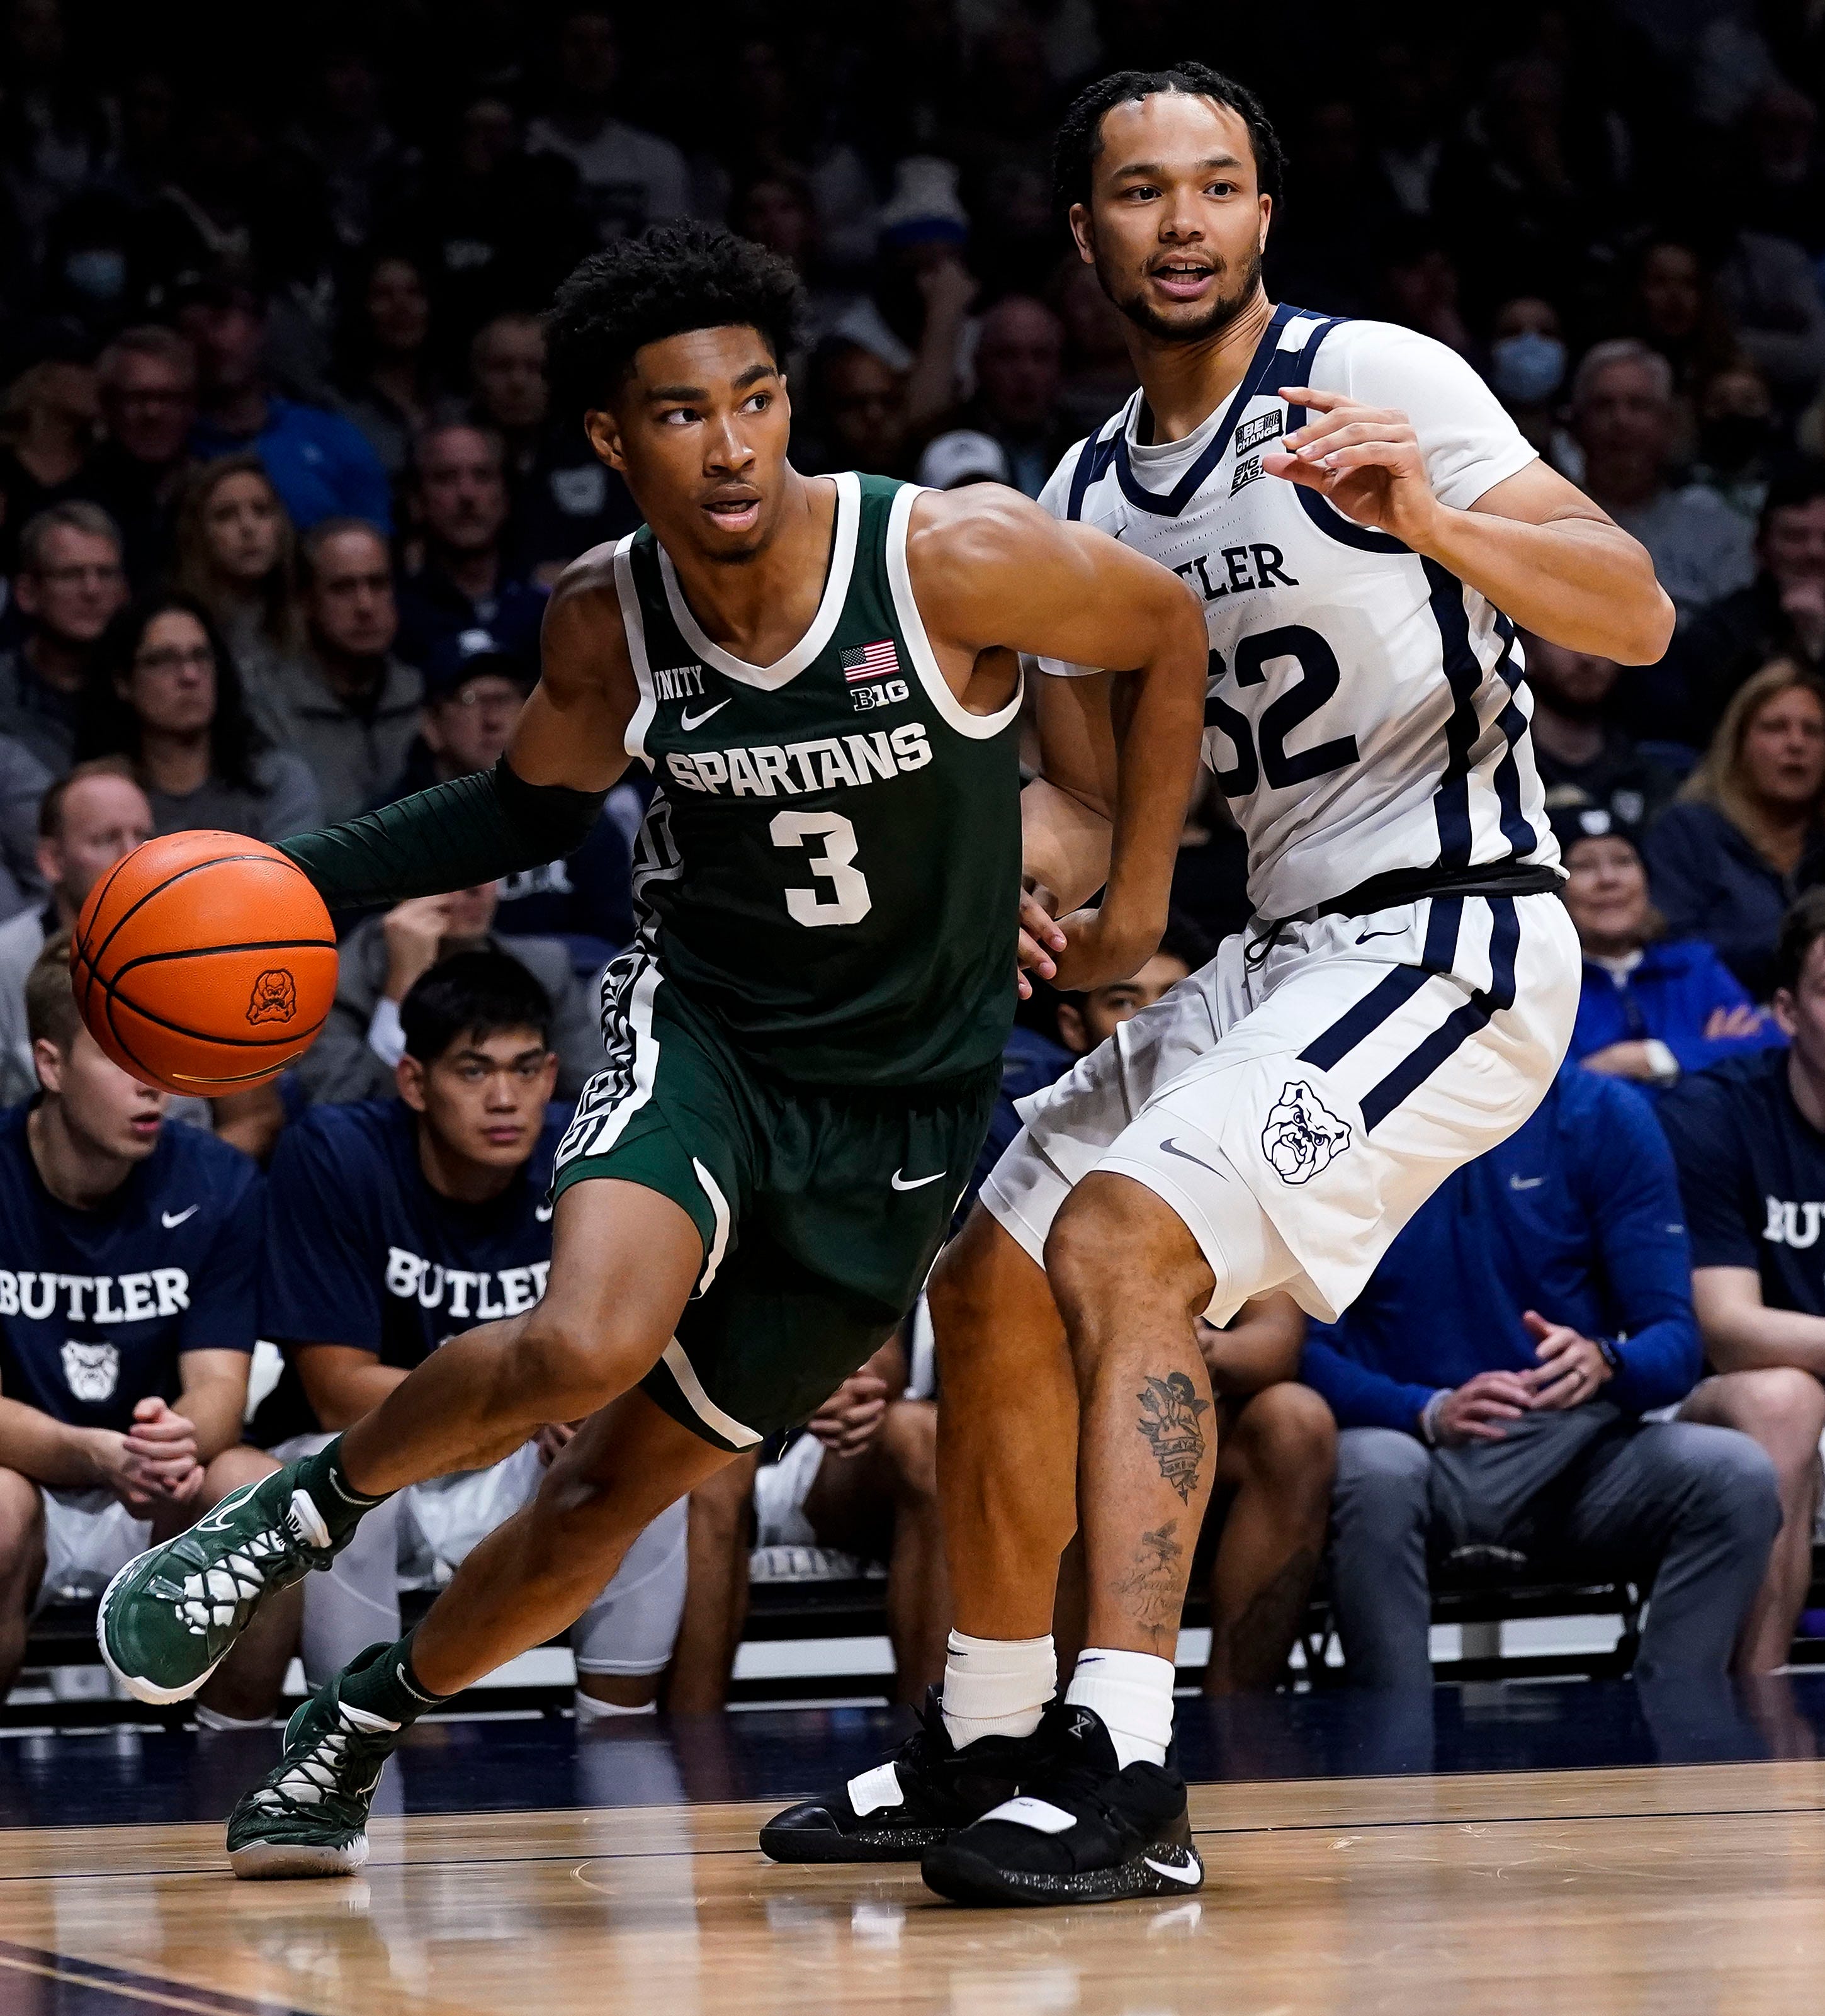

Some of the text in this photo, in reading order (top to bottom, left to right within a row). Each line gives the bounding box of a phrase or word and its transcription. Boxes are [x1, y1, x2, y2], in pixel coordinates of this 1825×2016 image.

[1236, 423, 1280, 453] CHANGE
[1243, 417, 1264, 439] BE
[1234, 454, 1260, 479] BIG
[665, 722, 934, 796] SPARTANS
[769, 810, 872, 927] 3
[0, 1267, 191, 1324] BUTLER
